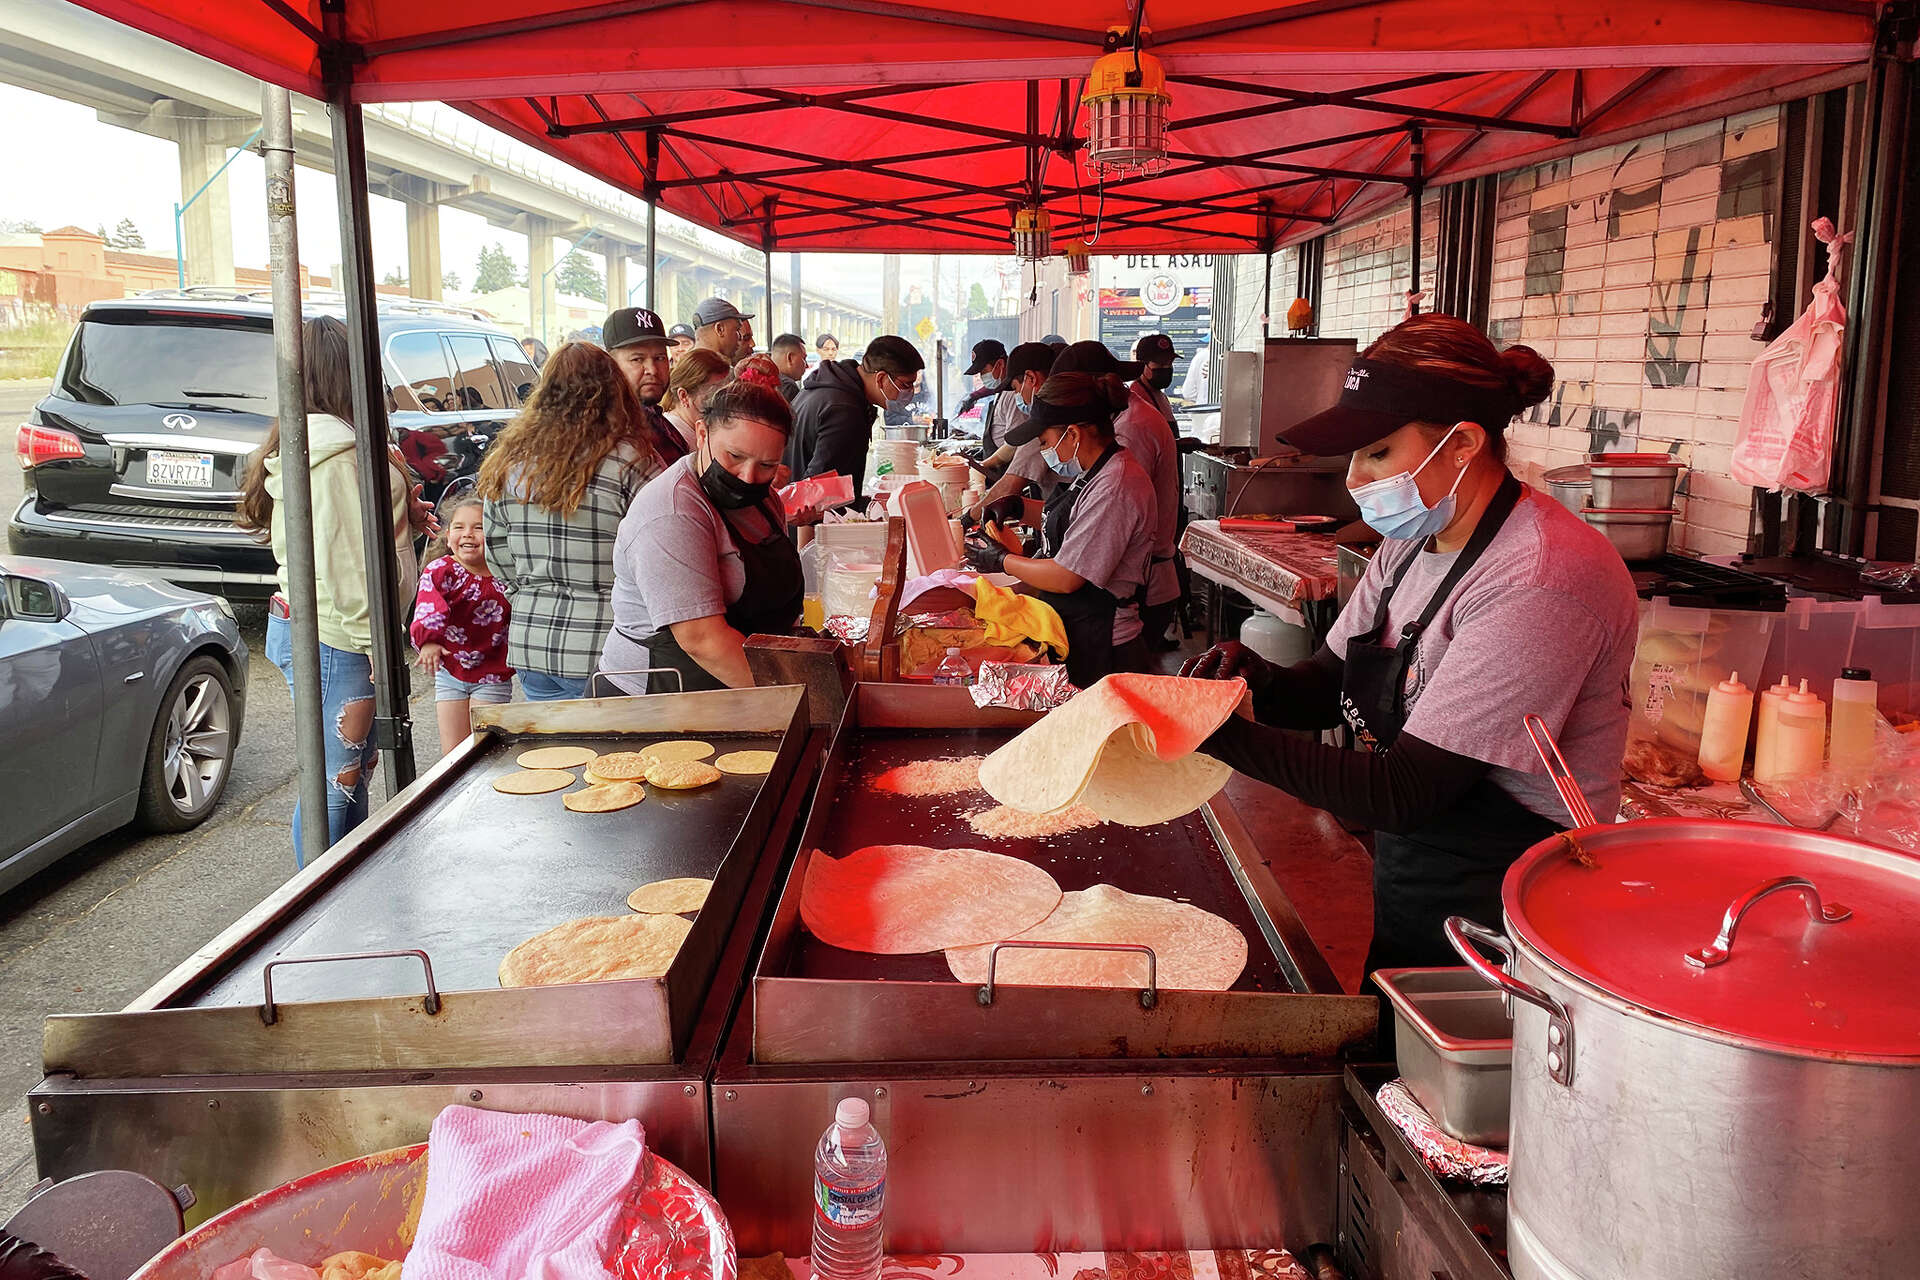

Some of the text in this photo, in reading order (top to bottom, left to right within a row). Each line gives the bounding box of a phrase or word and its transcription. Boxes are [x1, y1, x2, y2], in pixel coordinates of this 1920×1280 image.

[1127, 254, 1160, 269] DEL
[635, 310, 653, 329] NY
[152, 463, 207, 482] 8ZVR771
